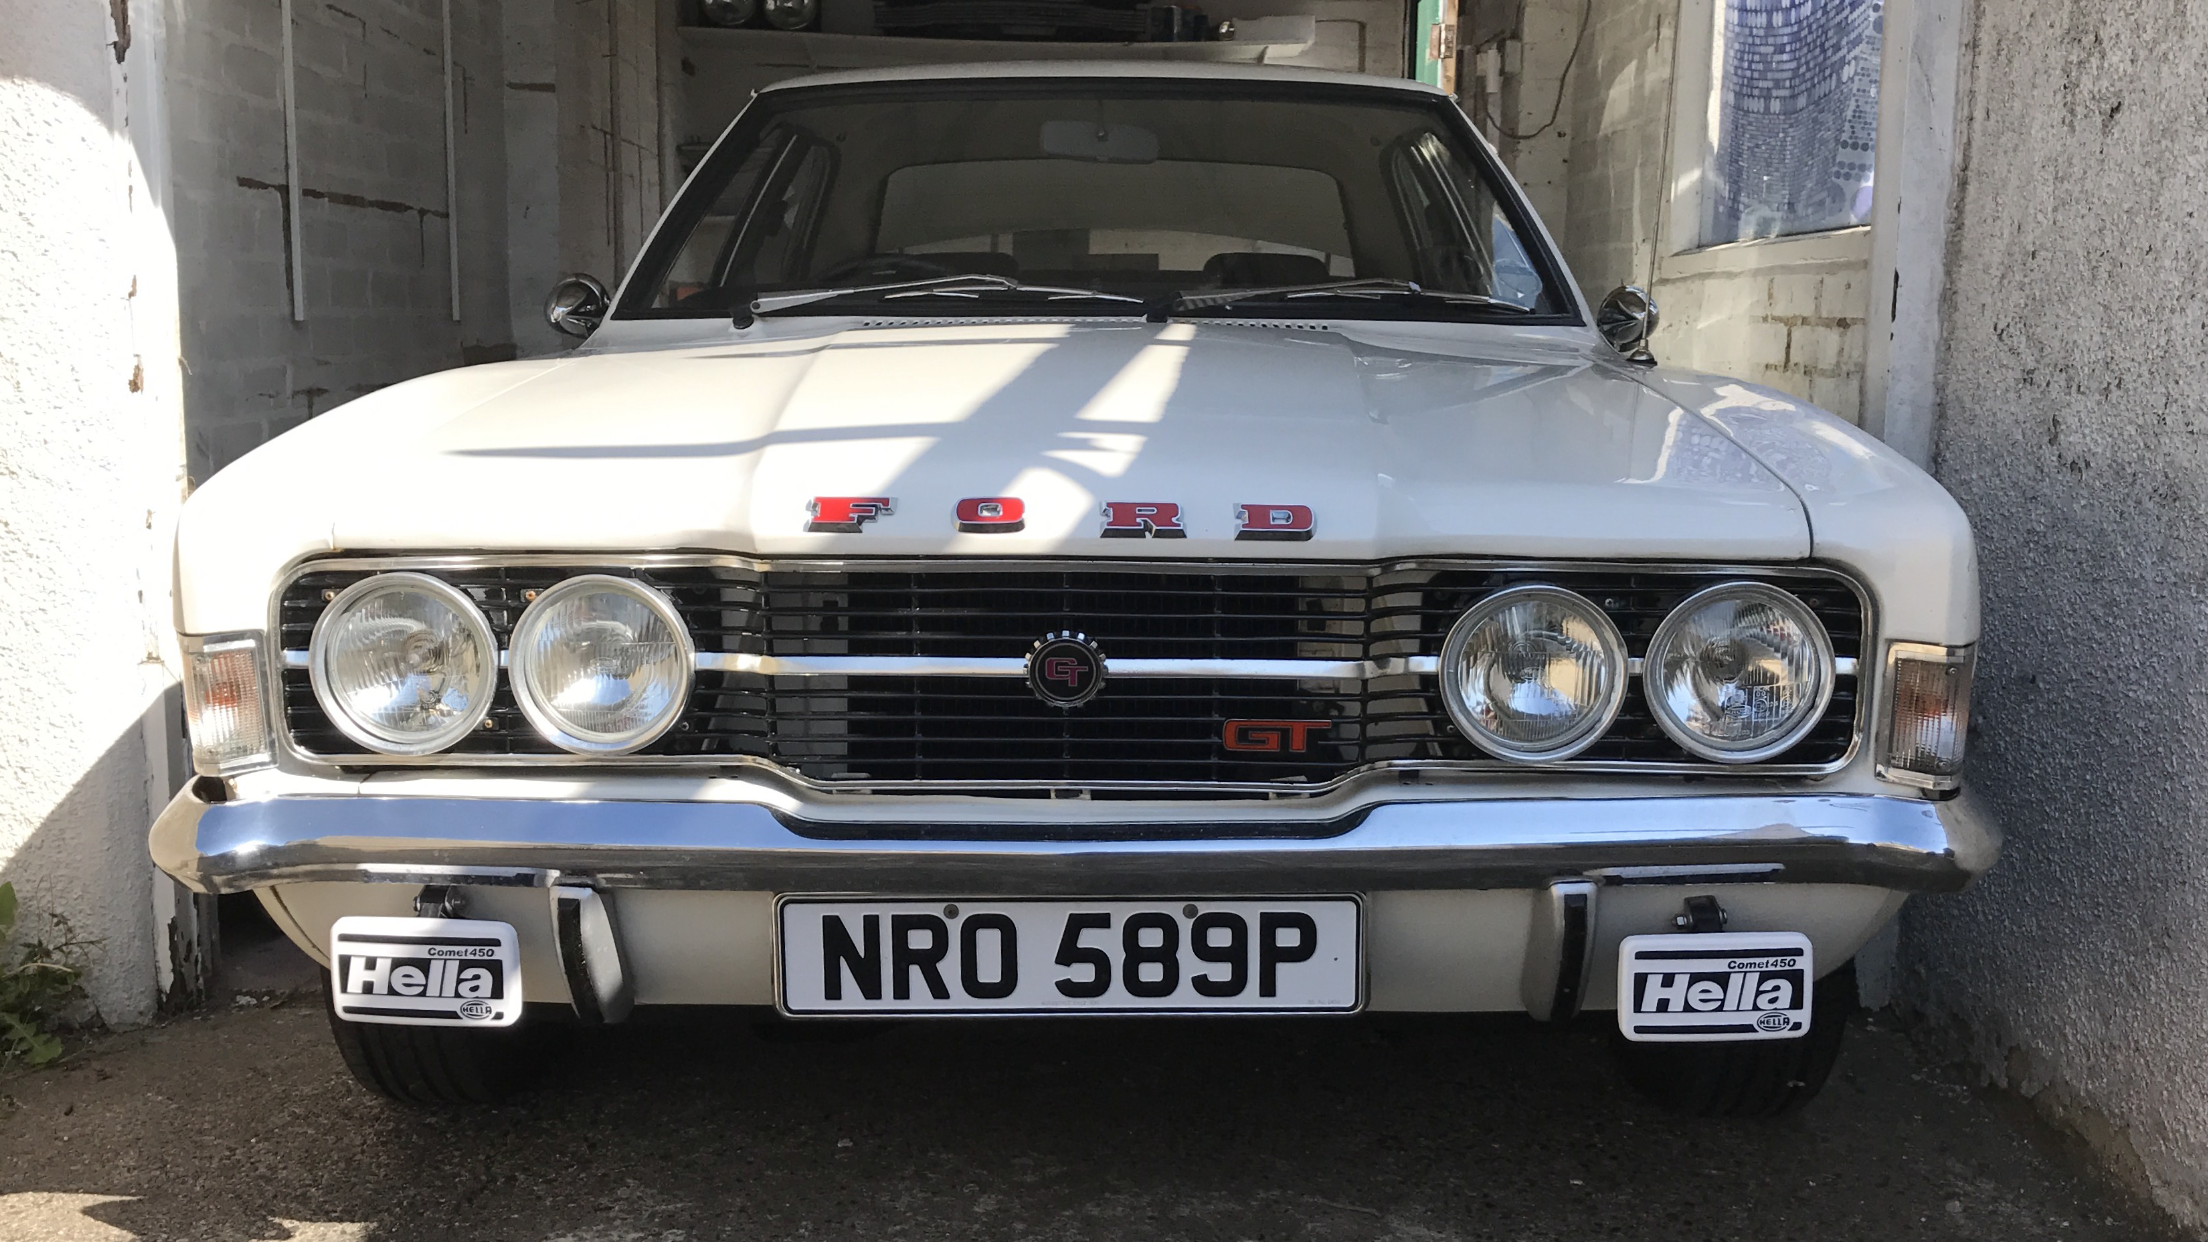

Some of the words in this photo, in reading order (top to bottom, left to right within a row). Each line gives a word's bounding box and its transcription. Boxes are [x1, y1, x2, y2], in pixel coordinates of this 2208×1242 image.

[807, 495, 1318, 541] FORD
[1045, 657, 1089, 687] GT
[1223, 718, 1332, 752] GT
[822, 913, 1018, 1000] NRO
[1054, 912, 1317, 998] 589P
[346, 955, 493, 998] Hella
[1640, 972, 1793, 1012] Hella
[462, 1003, 492, 1015] HELLA
[1759, 1016, 1790, 1027] HELLA
